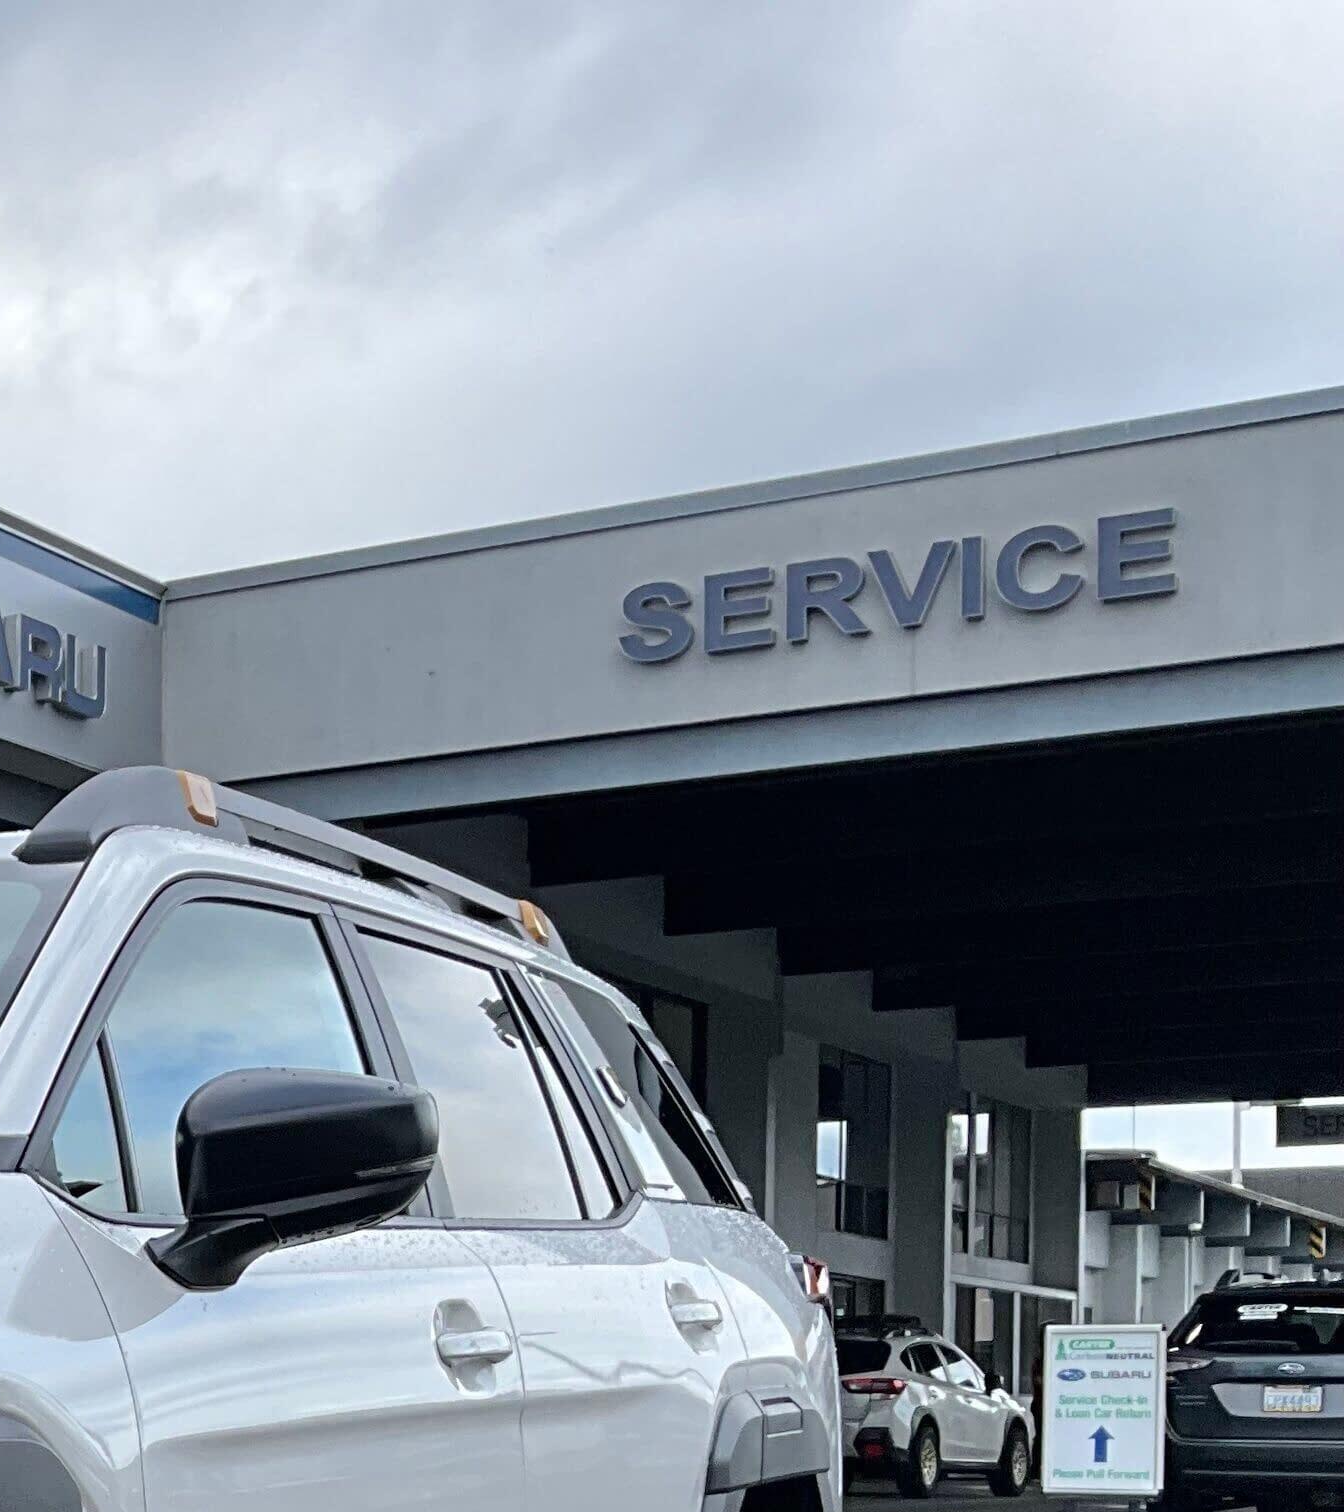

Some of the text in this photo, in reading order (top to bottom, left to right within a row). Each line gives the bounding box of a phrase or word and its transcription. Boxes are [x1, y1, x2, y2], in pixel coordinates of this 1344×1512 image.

[618, 507, 1179, 664] SERVICE
[1090, 1370, 1152, 1379] SUBARU
[1059, 1395, 1097, 1405] Service
[1094, 1408, 1113, 1418] Car
